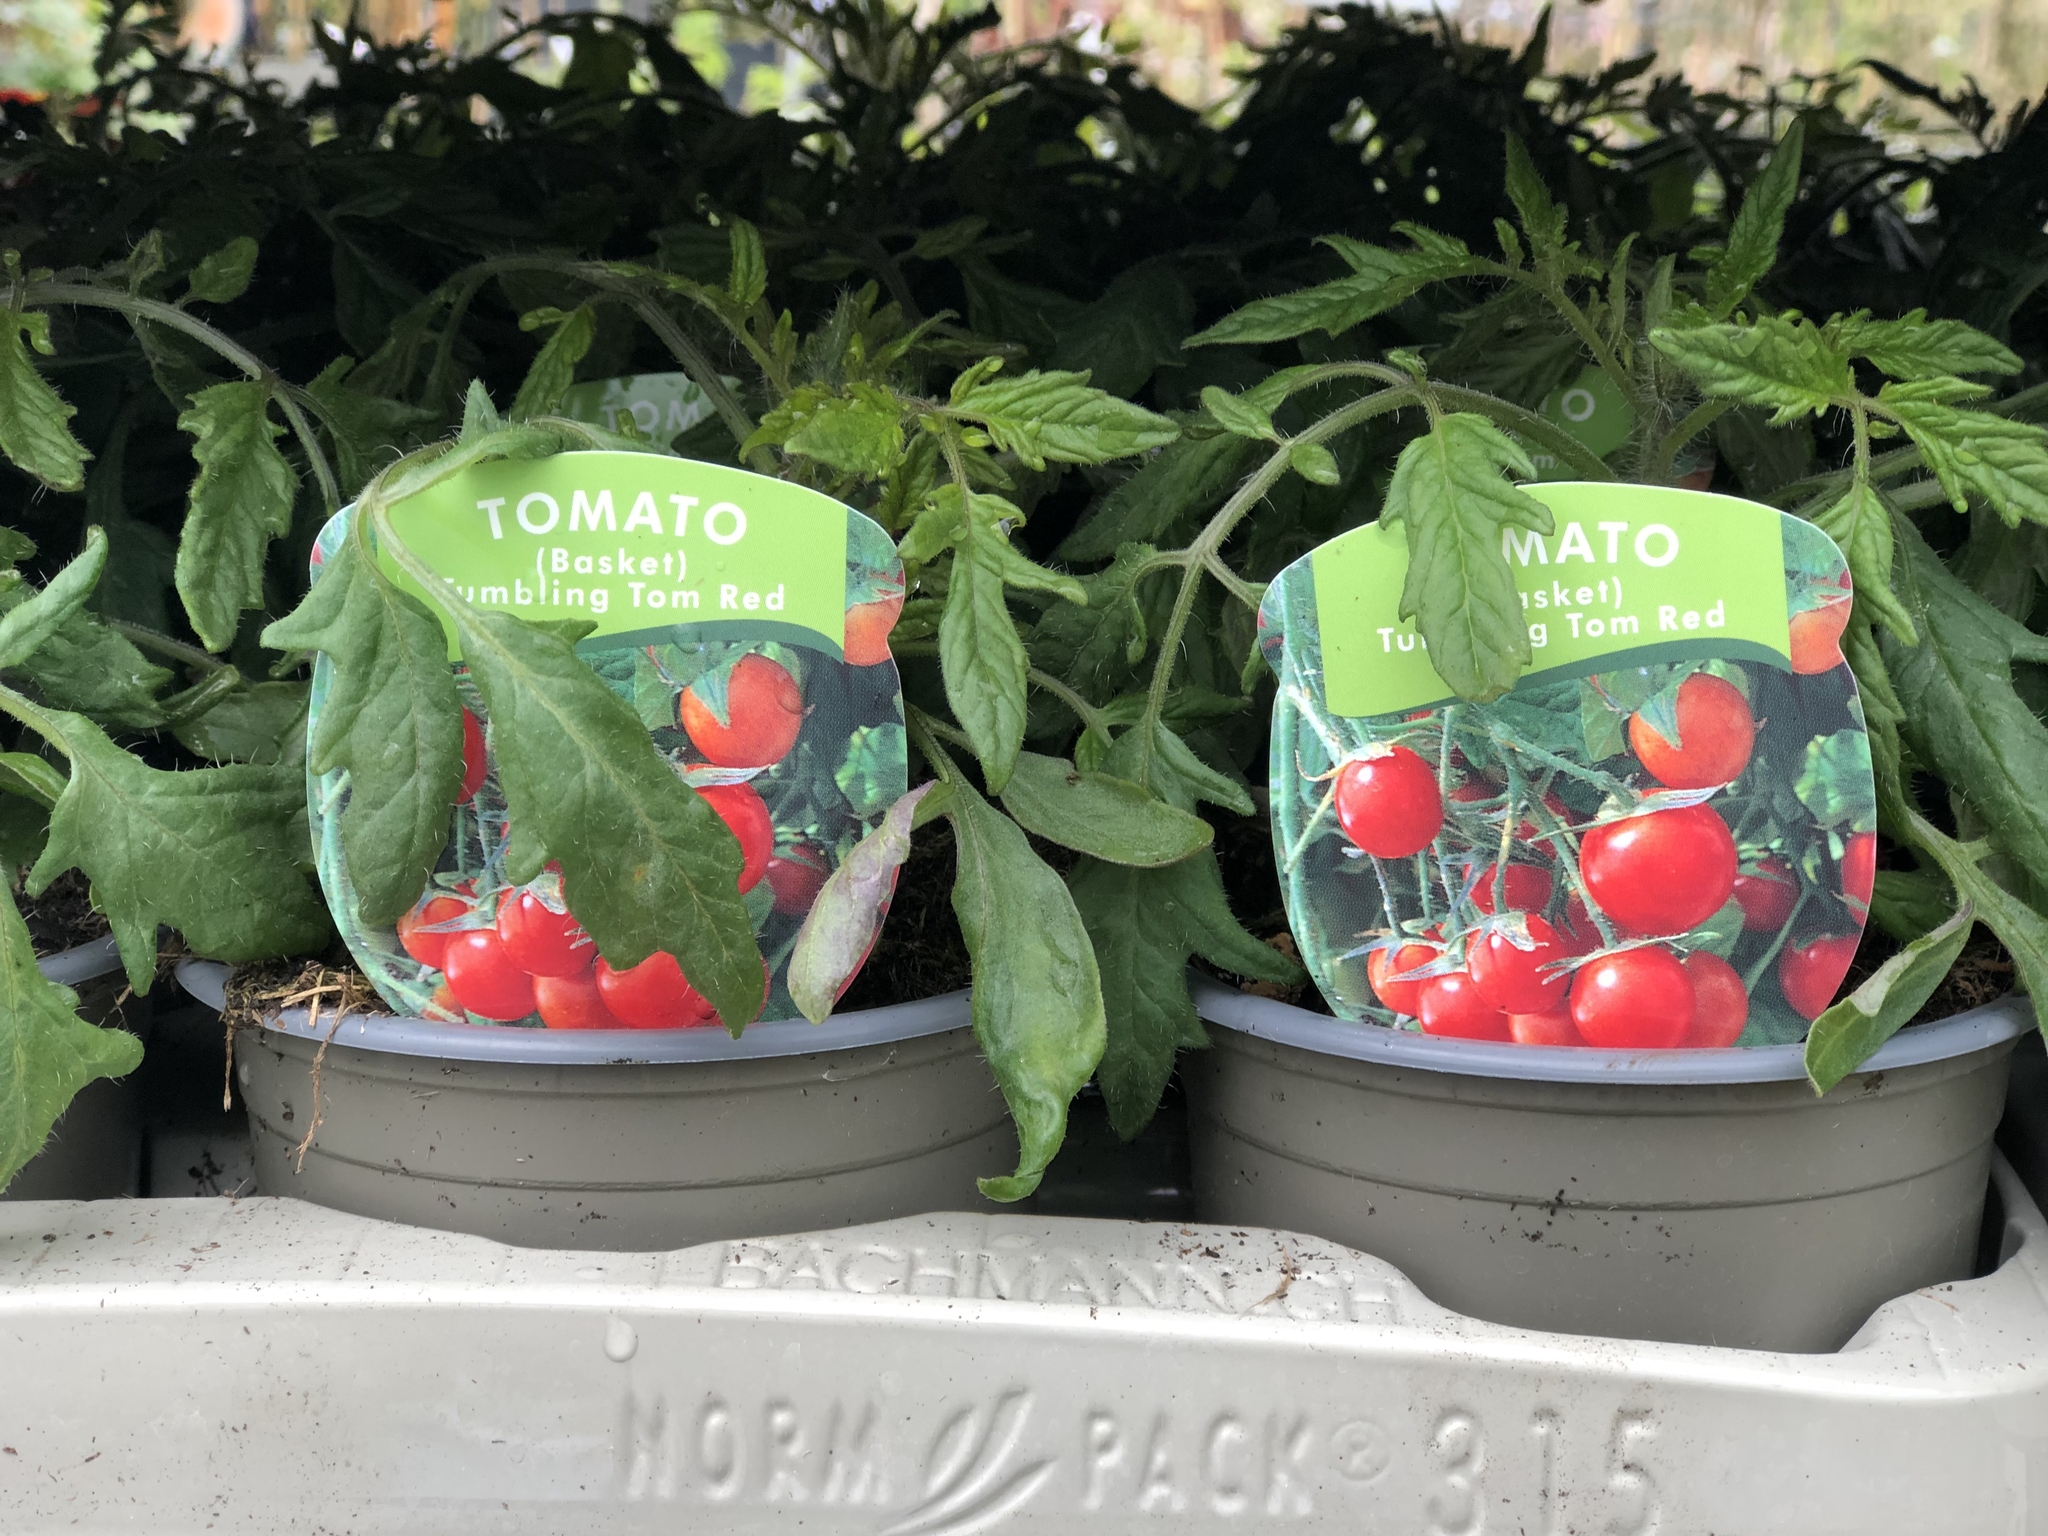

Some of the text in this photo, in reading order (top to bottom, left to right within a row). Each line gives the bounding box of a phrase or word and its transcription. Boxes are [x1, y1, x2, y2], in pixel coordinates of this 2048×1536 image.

[602, 400, 699, 433] TOM
[476, 489, 747, 545] TOMATO
[1502, 521, 1680, 567] MATO
[536, 546, 687, 582] (Basket)
[627, 580, 701, 610] Tom
[719, 583, 785, 611] Red
[1565, 612, 1639, 639] Tom
[1658, 600, 1726, 632] Red
[618, 1393, 894, 1502] NORM
